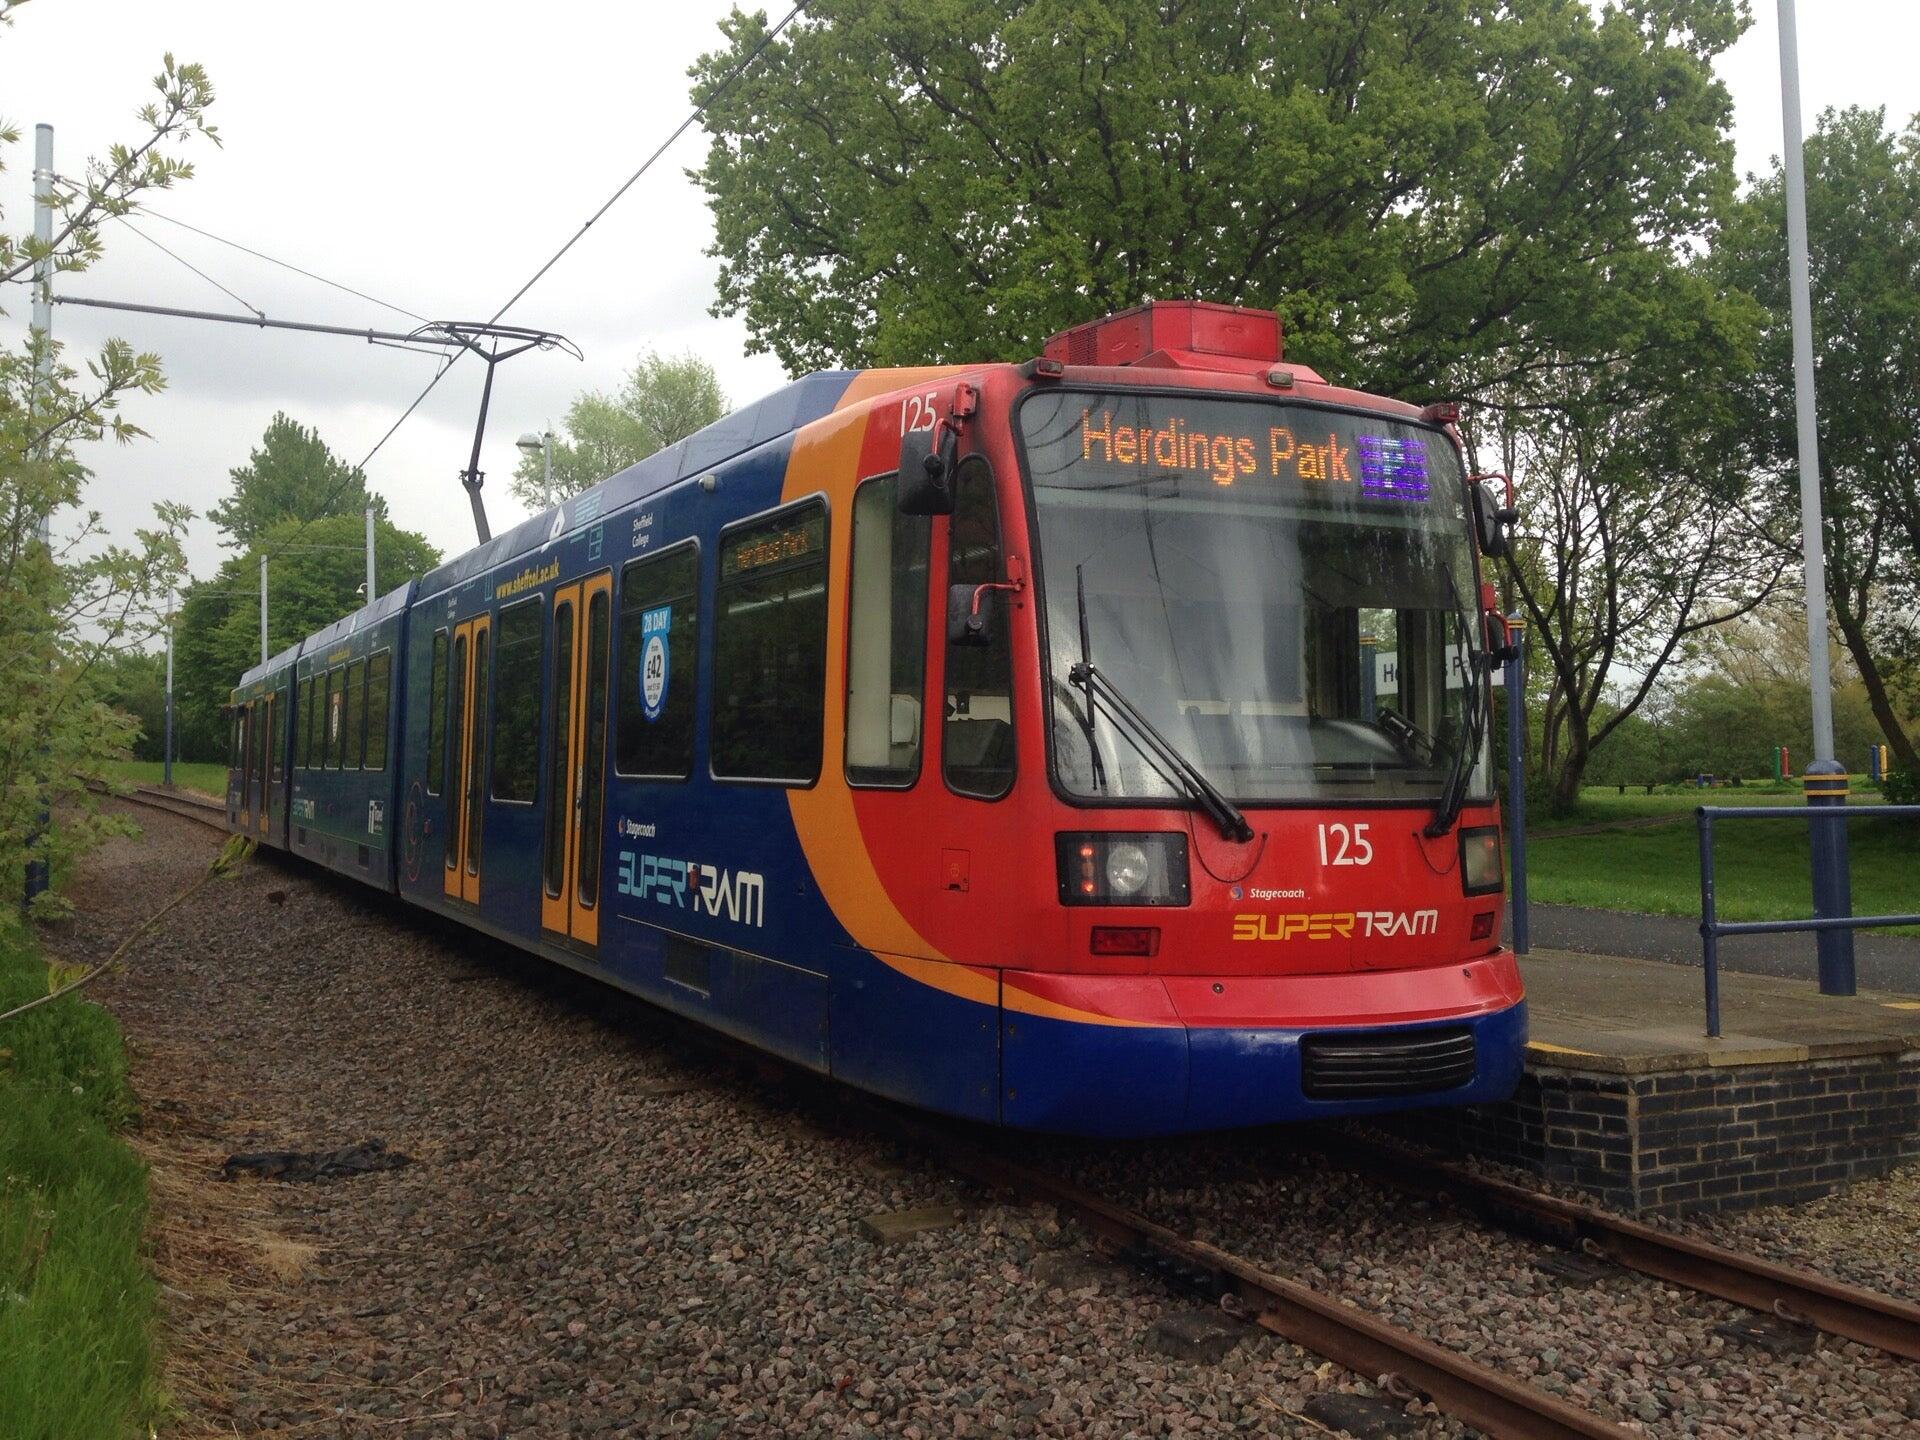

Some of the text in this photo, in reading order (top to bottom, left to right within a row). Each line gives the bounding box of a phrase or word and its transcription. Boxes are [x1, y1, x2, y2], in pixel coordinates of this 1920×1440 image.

[900, 391, 938, 438] 125
[1082, 408, 1257, 486] Herdings
[1269, 426, 1352, 482] Park
[632, 511, 654, 532] Sheffield
[643, 609, 669, 634] 28 DAY
[646, 654, 662, 680] £42
[626, 818, 656, 840] Stagecoach
[1317, 823, 1374, 866] 125
[1249, 887, 1305, 900] Stagecoach
[1232, 909, 1439, 941] SUPERTRAM
